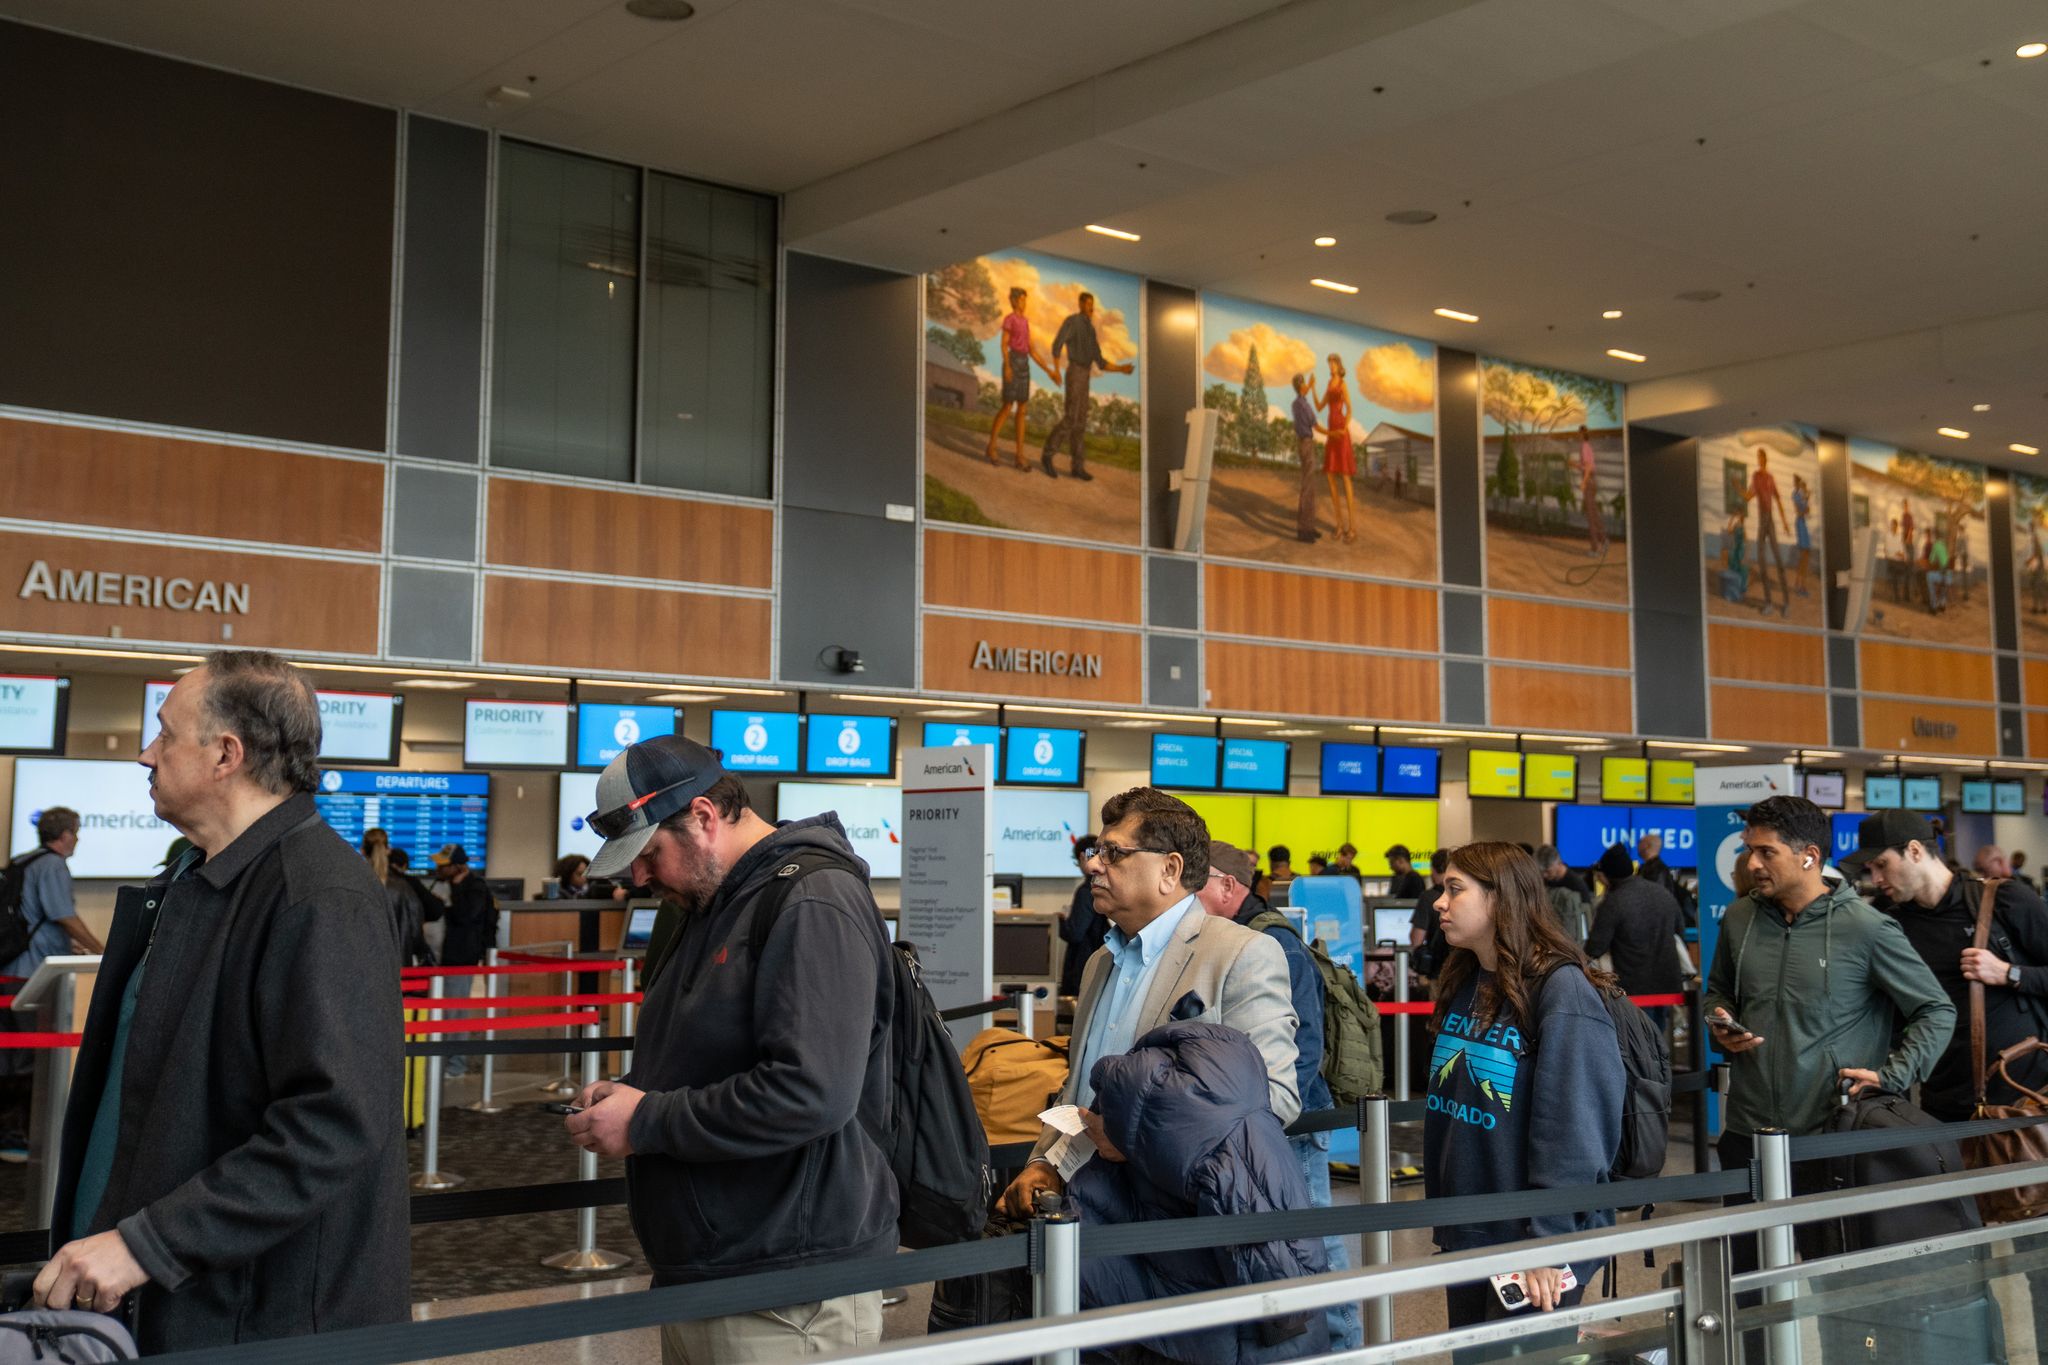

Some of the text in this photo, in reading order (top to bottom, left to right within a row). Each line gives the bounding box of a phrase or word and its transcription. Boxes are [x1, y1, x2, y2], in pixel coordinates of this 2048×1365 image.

[19, 559, 250, 615] AMERICAN
[972, 639, 1103, 679] AMERICAN
[319, 700, 367, 716] ORITY
[474, 707, 545, 724] PRIORITY
[622, 723, 632, 741] 2
[751, 730, 760, 746] 2
[846, 733, 855, 749] 2
[923, 762, 963, 775] American
[375, 775, 450, 790] DEPARTURES
[1719, 778, 1764, 790] American
[79, 809, 172, 829] merican
[909, 807, 960, 821] PRIORITY
[845, 823, 880, 840] rican
[1002, 825, 1062, 842] American
[1442, 1012, 1521, 1051] ENVER
[1427, 1094, 1496, 1130] OLORADO
